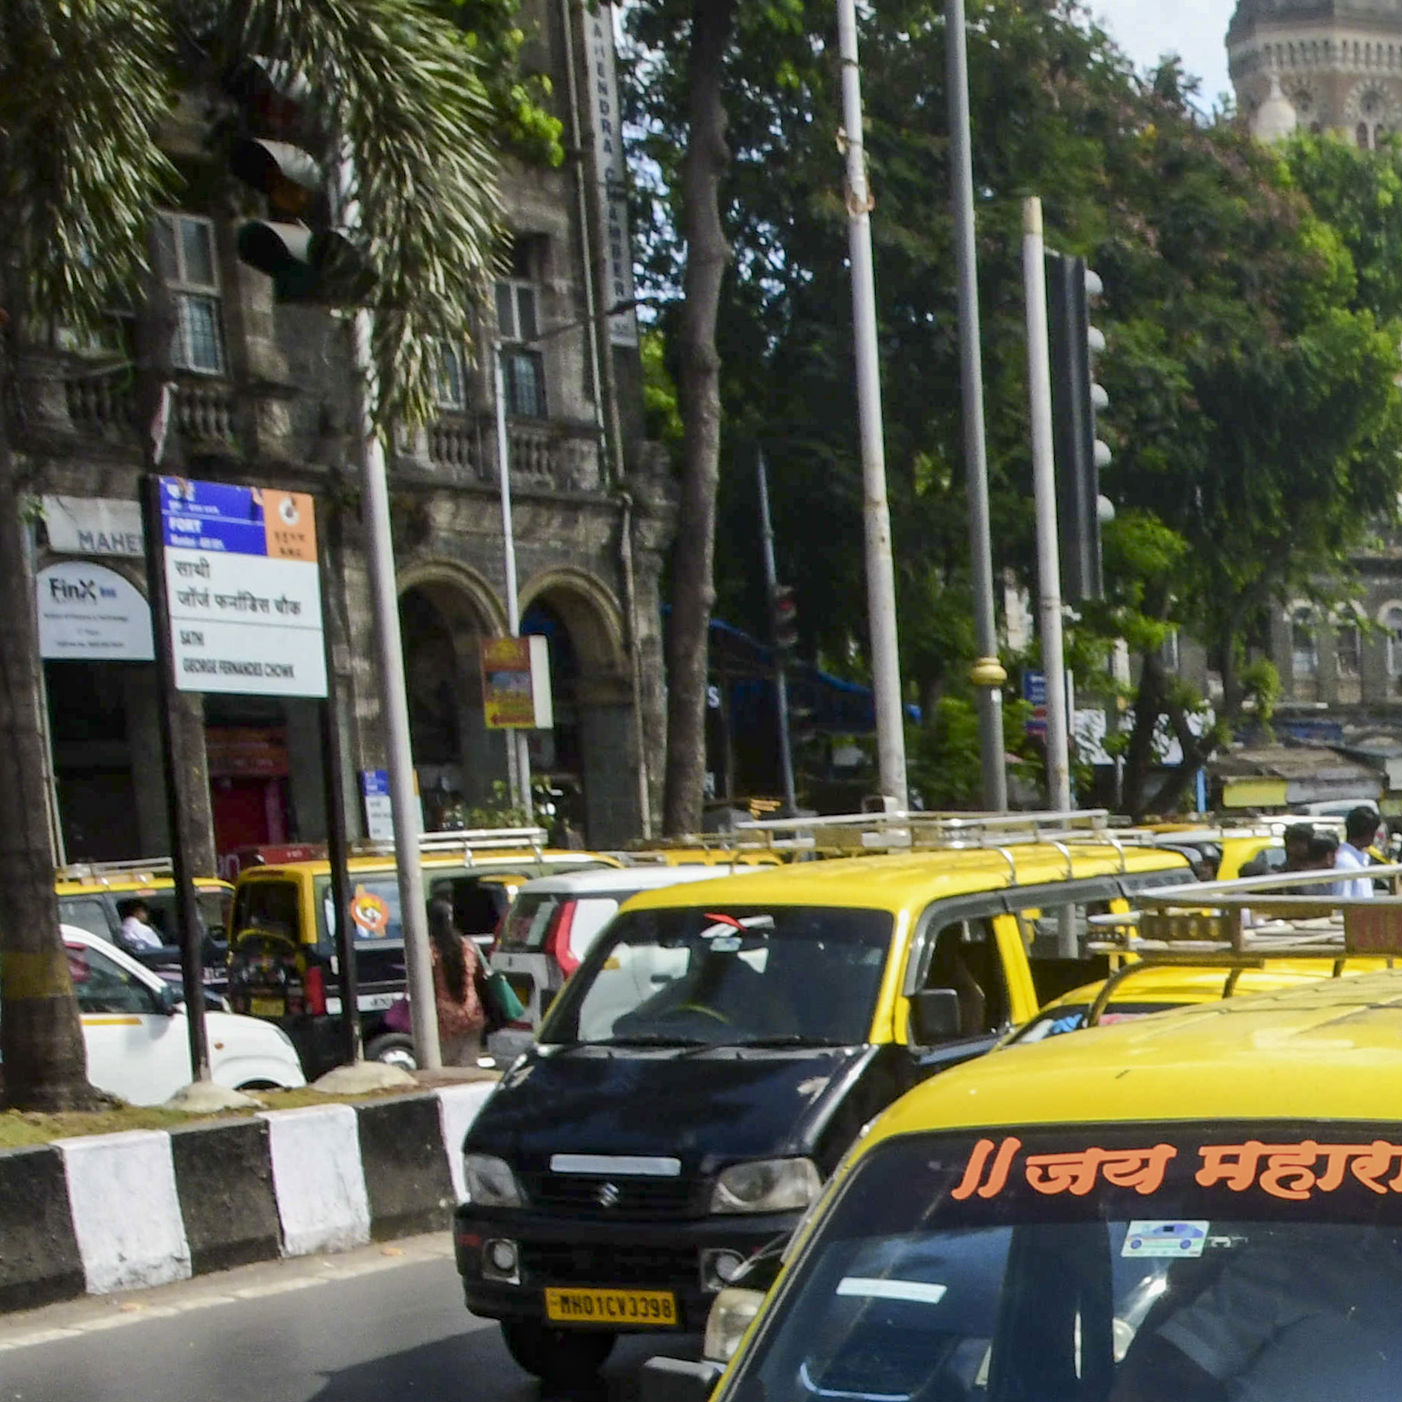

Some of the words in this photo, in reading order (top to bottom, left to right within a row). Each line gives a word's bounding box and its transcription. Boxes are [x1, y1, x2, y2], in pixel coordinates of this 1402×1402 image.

[77, 529, 144, 553] MAHE
[174, 556, 211, 579] साथी
[49, 577, 97, 601] FinX
[560, 1295, 672, 1318] MH01CV3398
